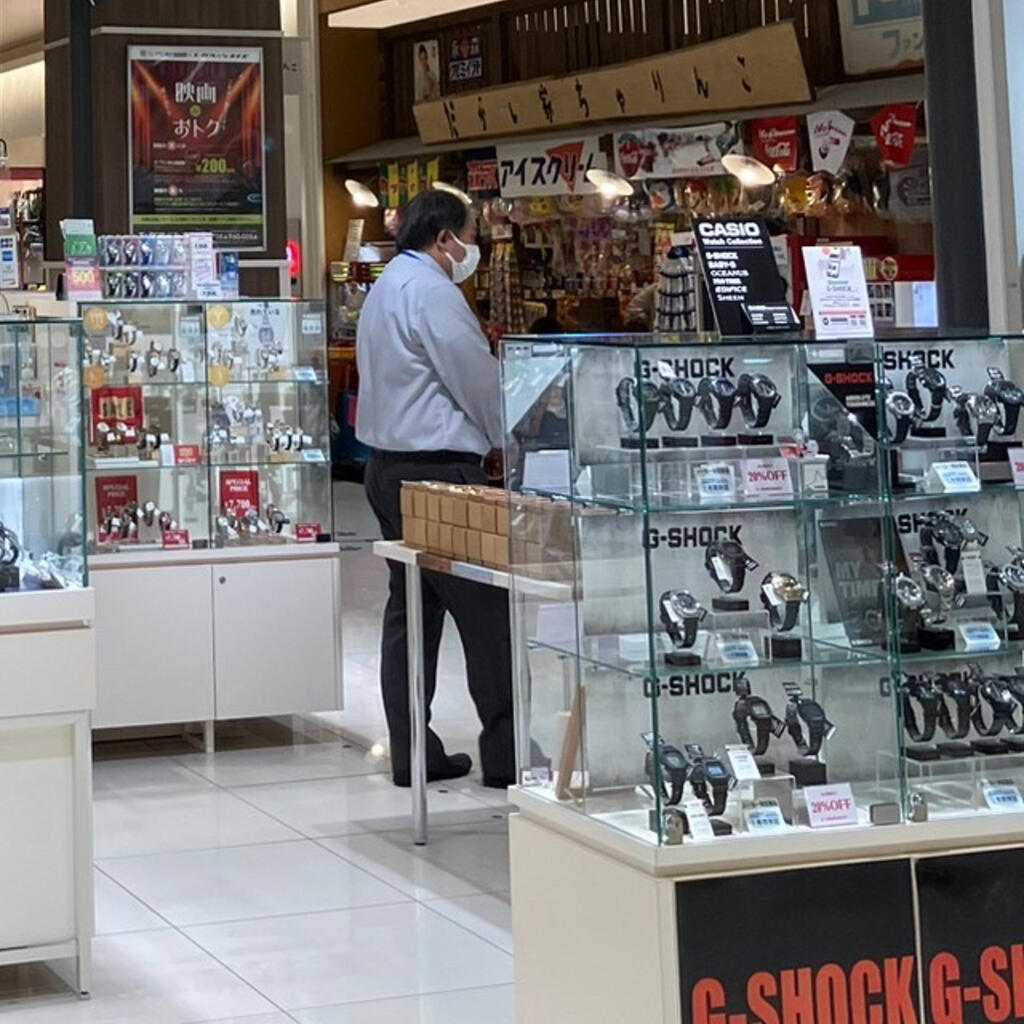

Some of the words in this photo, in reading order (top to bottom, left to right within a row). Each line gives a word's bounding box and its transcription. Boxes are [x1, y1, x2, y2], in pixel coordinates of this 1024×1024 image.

[175, 82, 216, 103] 映画
[173, 119, 221, 138] おトク
[699, 222, 760, 236] CASIO
[824, 372, 873, 384] G-SHOCK
[691, 955, 915, 1024] G-SHOCK
